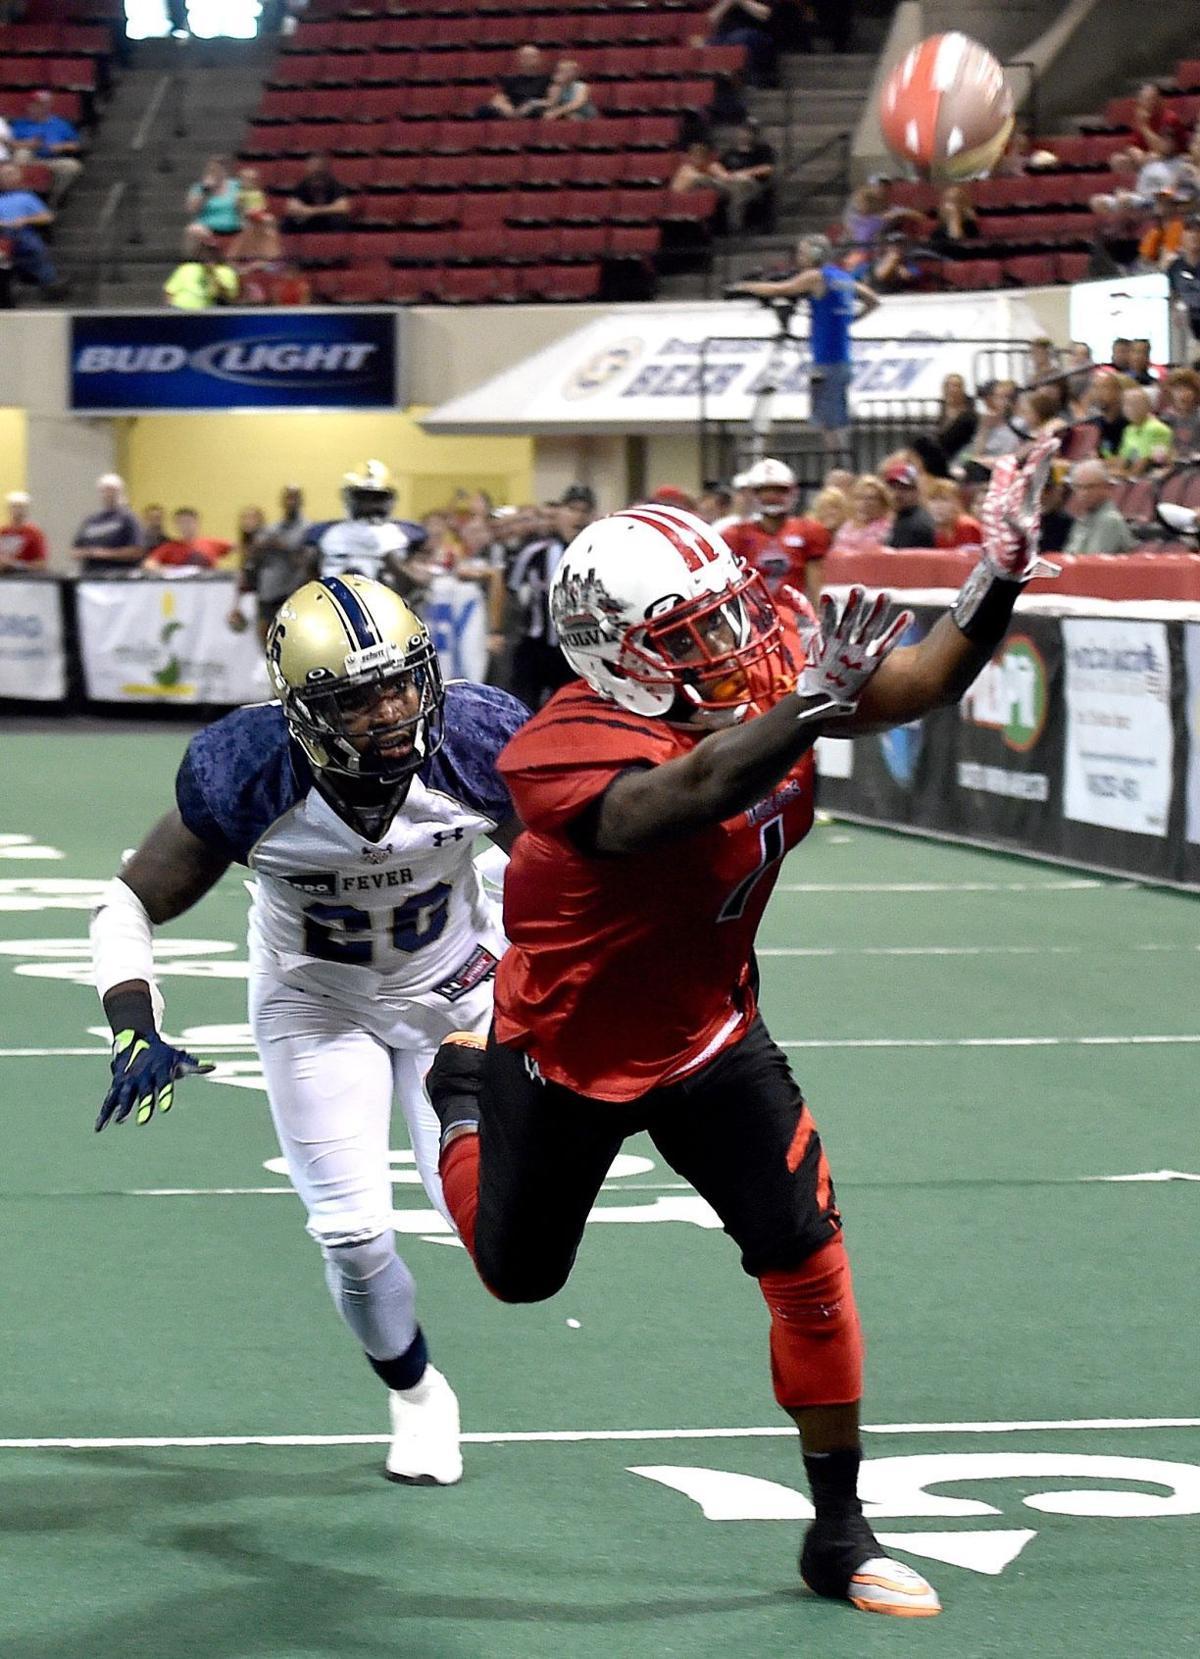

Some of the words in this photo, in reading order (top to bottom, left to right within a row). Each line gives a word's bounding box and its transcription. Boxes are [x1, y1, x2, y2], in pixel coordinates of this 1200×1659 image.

[76, 344, 188, 373] BUD
[222, 343, 377, 371] LIGHT
[341, 867, 415, 892] FEVER
